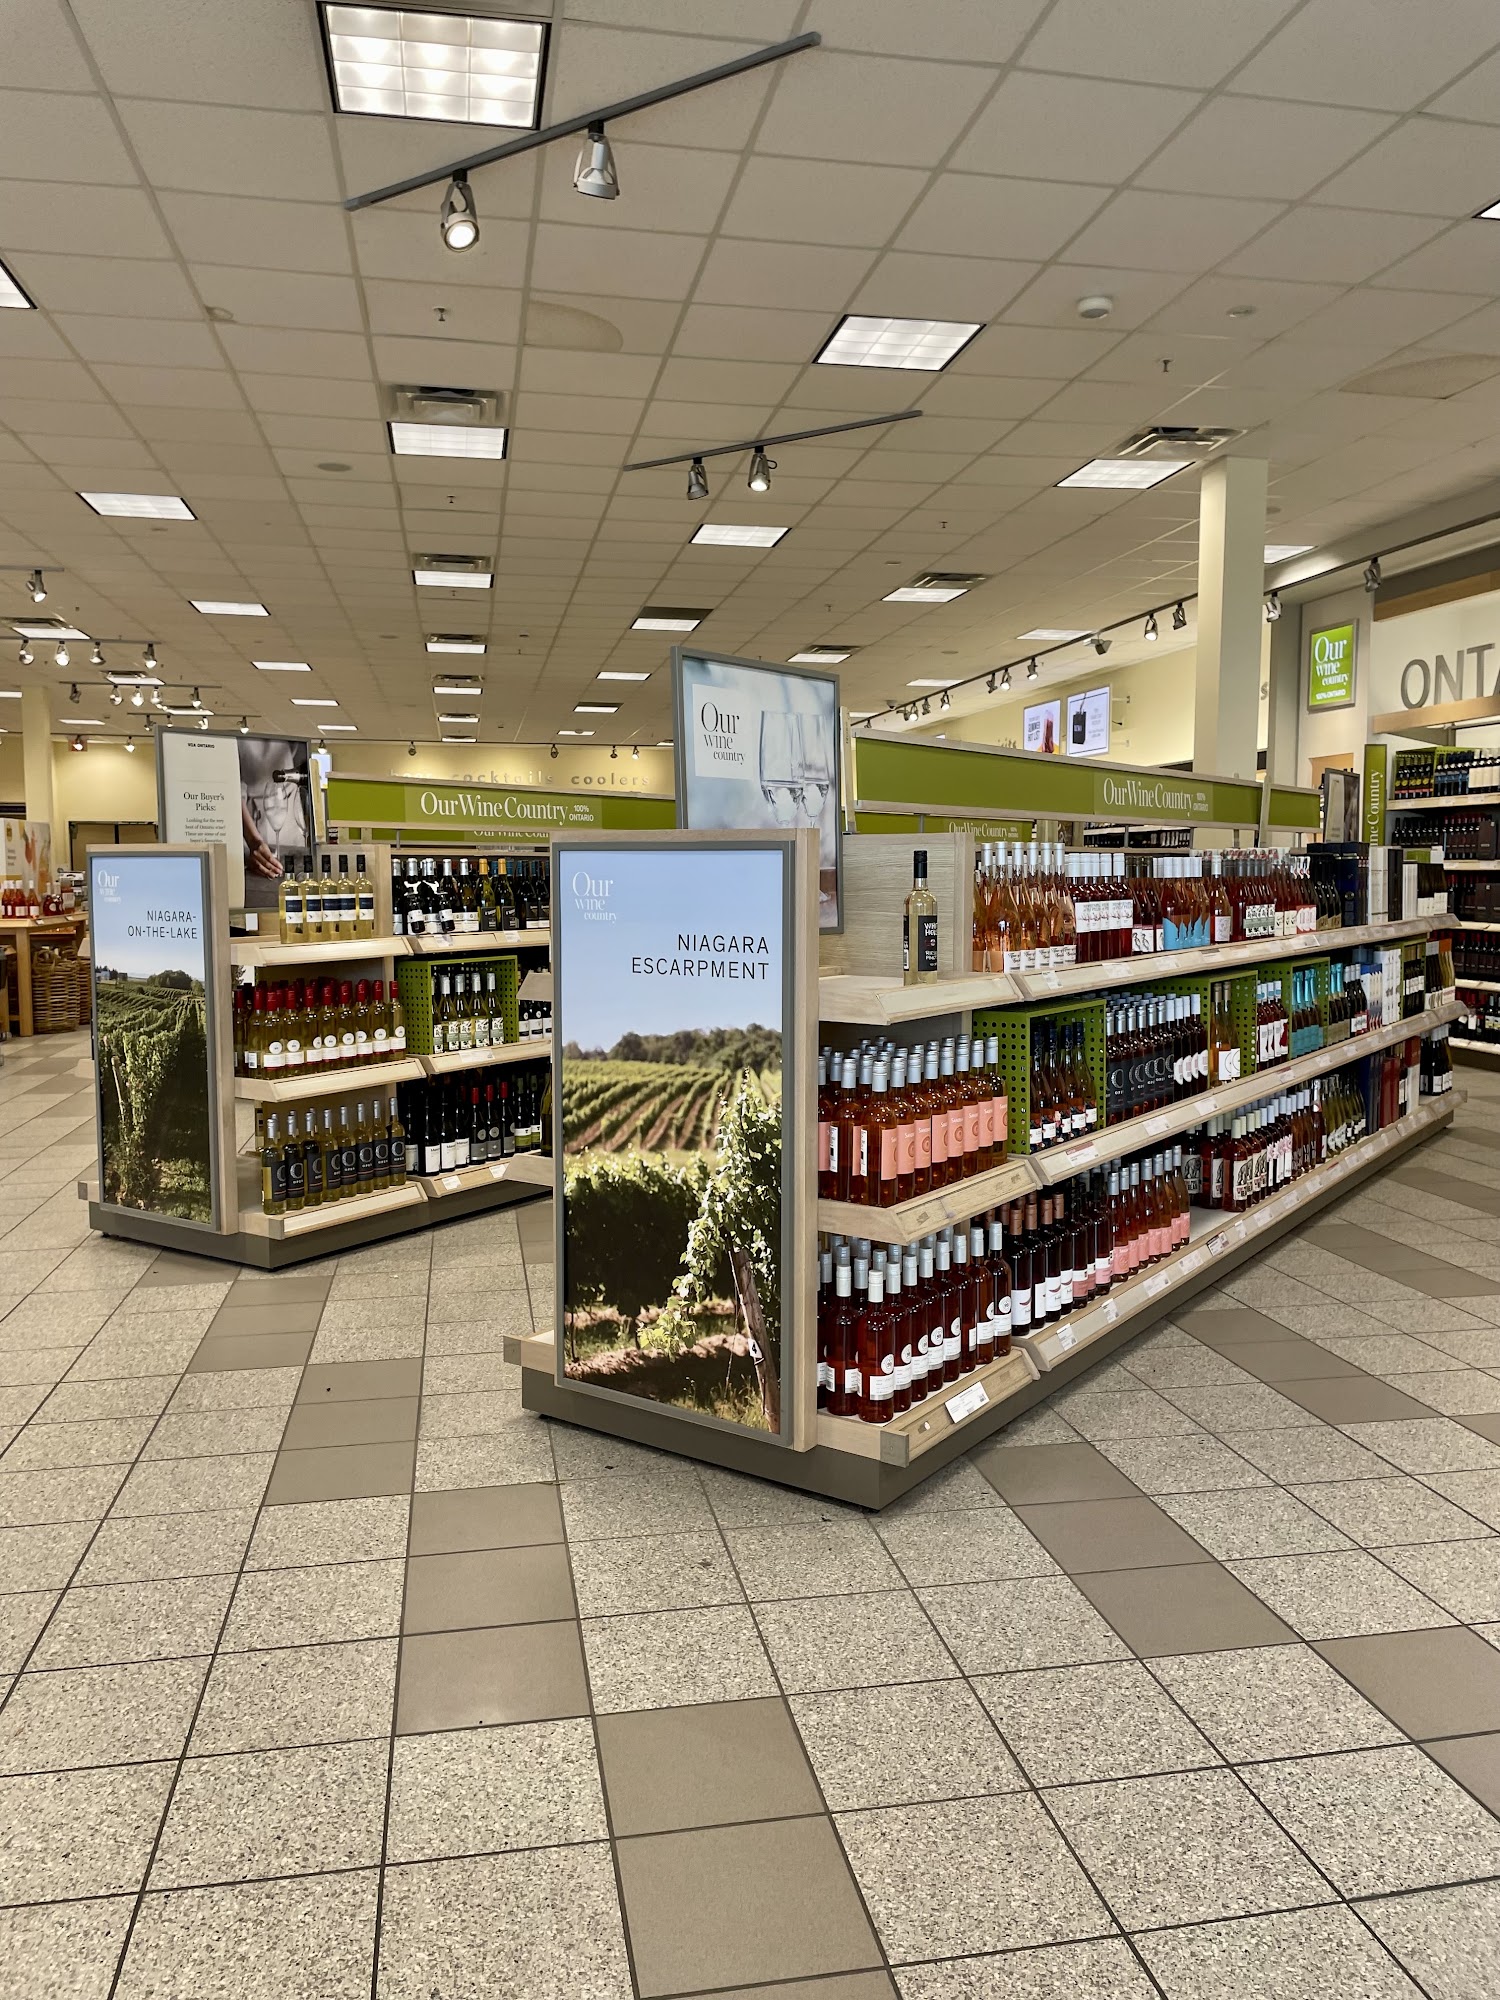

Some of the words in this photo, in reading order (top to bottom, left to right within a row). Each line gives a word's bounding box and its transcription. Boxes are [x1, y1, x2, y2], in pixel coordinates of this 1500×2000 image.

[1315, 636, 1347, 664] Our
[1316, 662, 1340, 677] wine
[1401, 643, 1500, 710] ONT
[1322, 674, 1349, 686] country
[701, 702, 740, 734] Our
[703, 734, 733, 750] wine
[713, 750, 745, 765] country
[571, 772, 649, 786] coolers
[183, 791, 199, 801] Our
[200, 792, 225, 803] Buyer's
[195, 803, 216, 812] Picks:
[420, 791, 457, 816] Our
[457, 793, 503, 818] Wine
[504, 796, 568, 826] Country
[573, 804, 589, 812] 100%
[569, 813, 594, 822] ONTARIO
[98, 870, 119, 887] Our
[572, 871, 614, 897] Our
[575, 898, 606, 911] wine
[147, 910, 196, 922] NIAGARA-
[584, 911, 617, 924] country
[128, 925, 198, 939] ON-THE-LAKE
[678, 934, 769, 954] NIAGARA
[632, 957, 769, 980] ESCARPMENT
